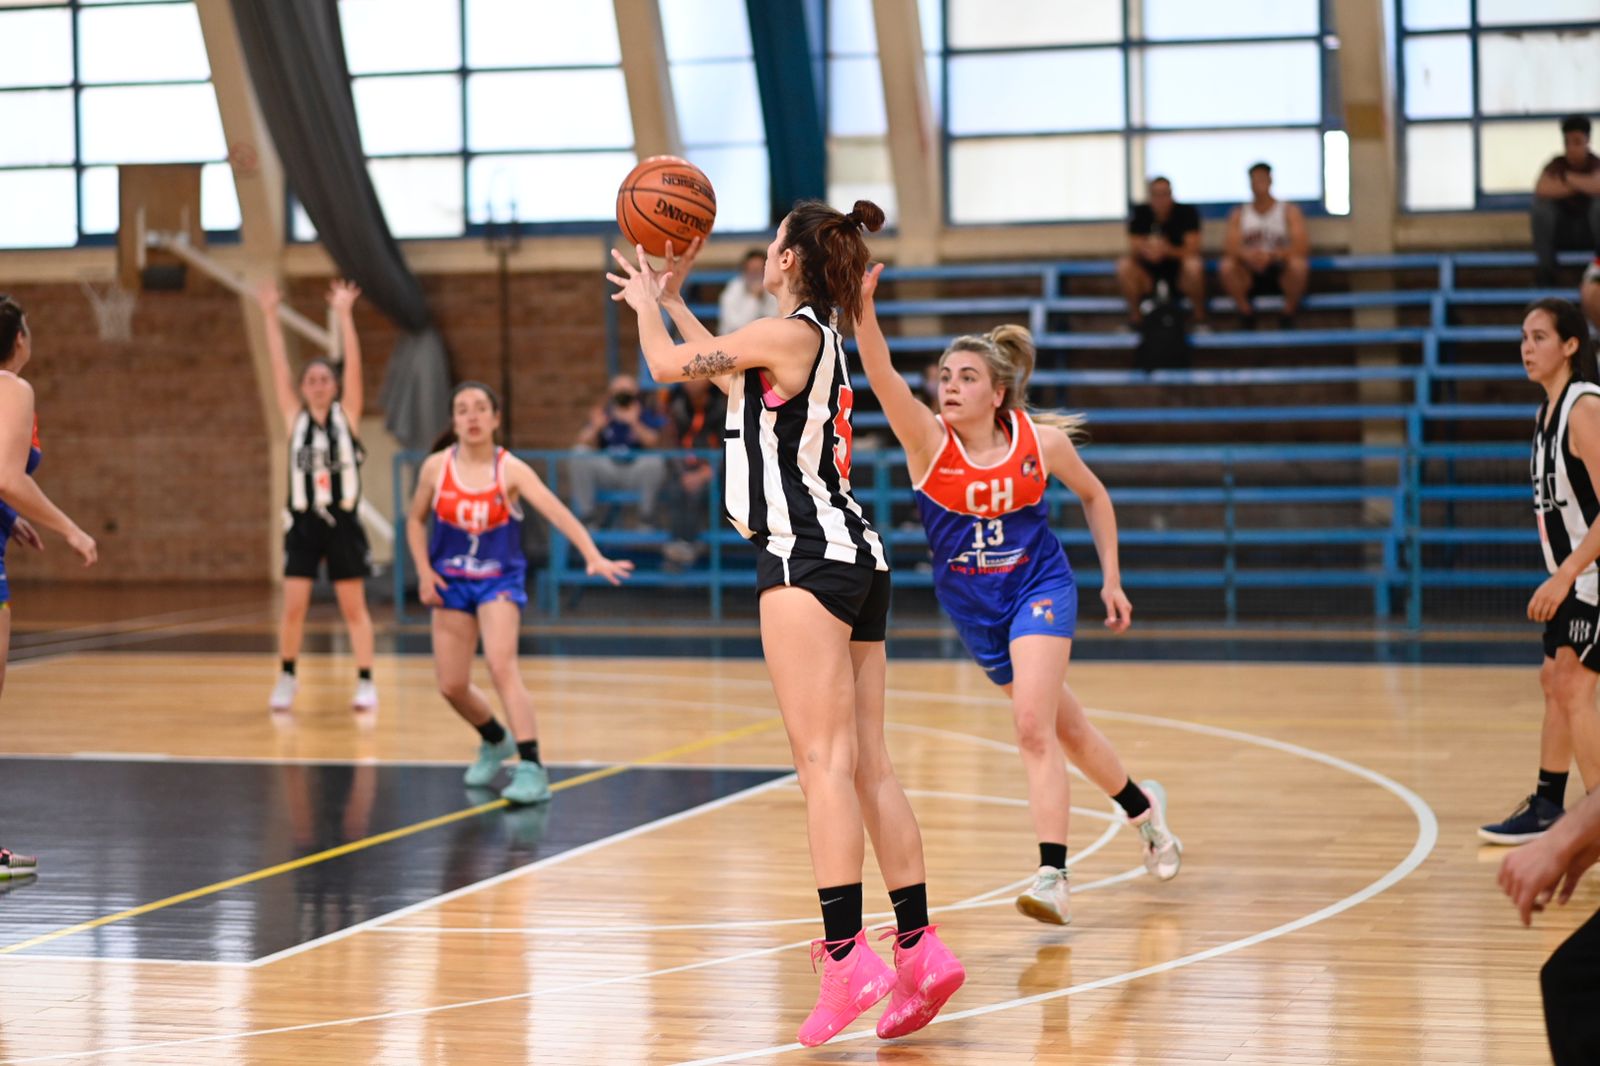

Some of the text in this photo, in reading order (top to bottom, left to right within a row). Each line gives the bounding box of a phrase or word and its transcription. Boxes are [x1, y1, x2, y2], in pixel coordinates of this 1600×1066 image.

[965, 477, 1014, 513] CH
[456, 499, 489, 529] CH
[972, 518, 1005, 549] 13
